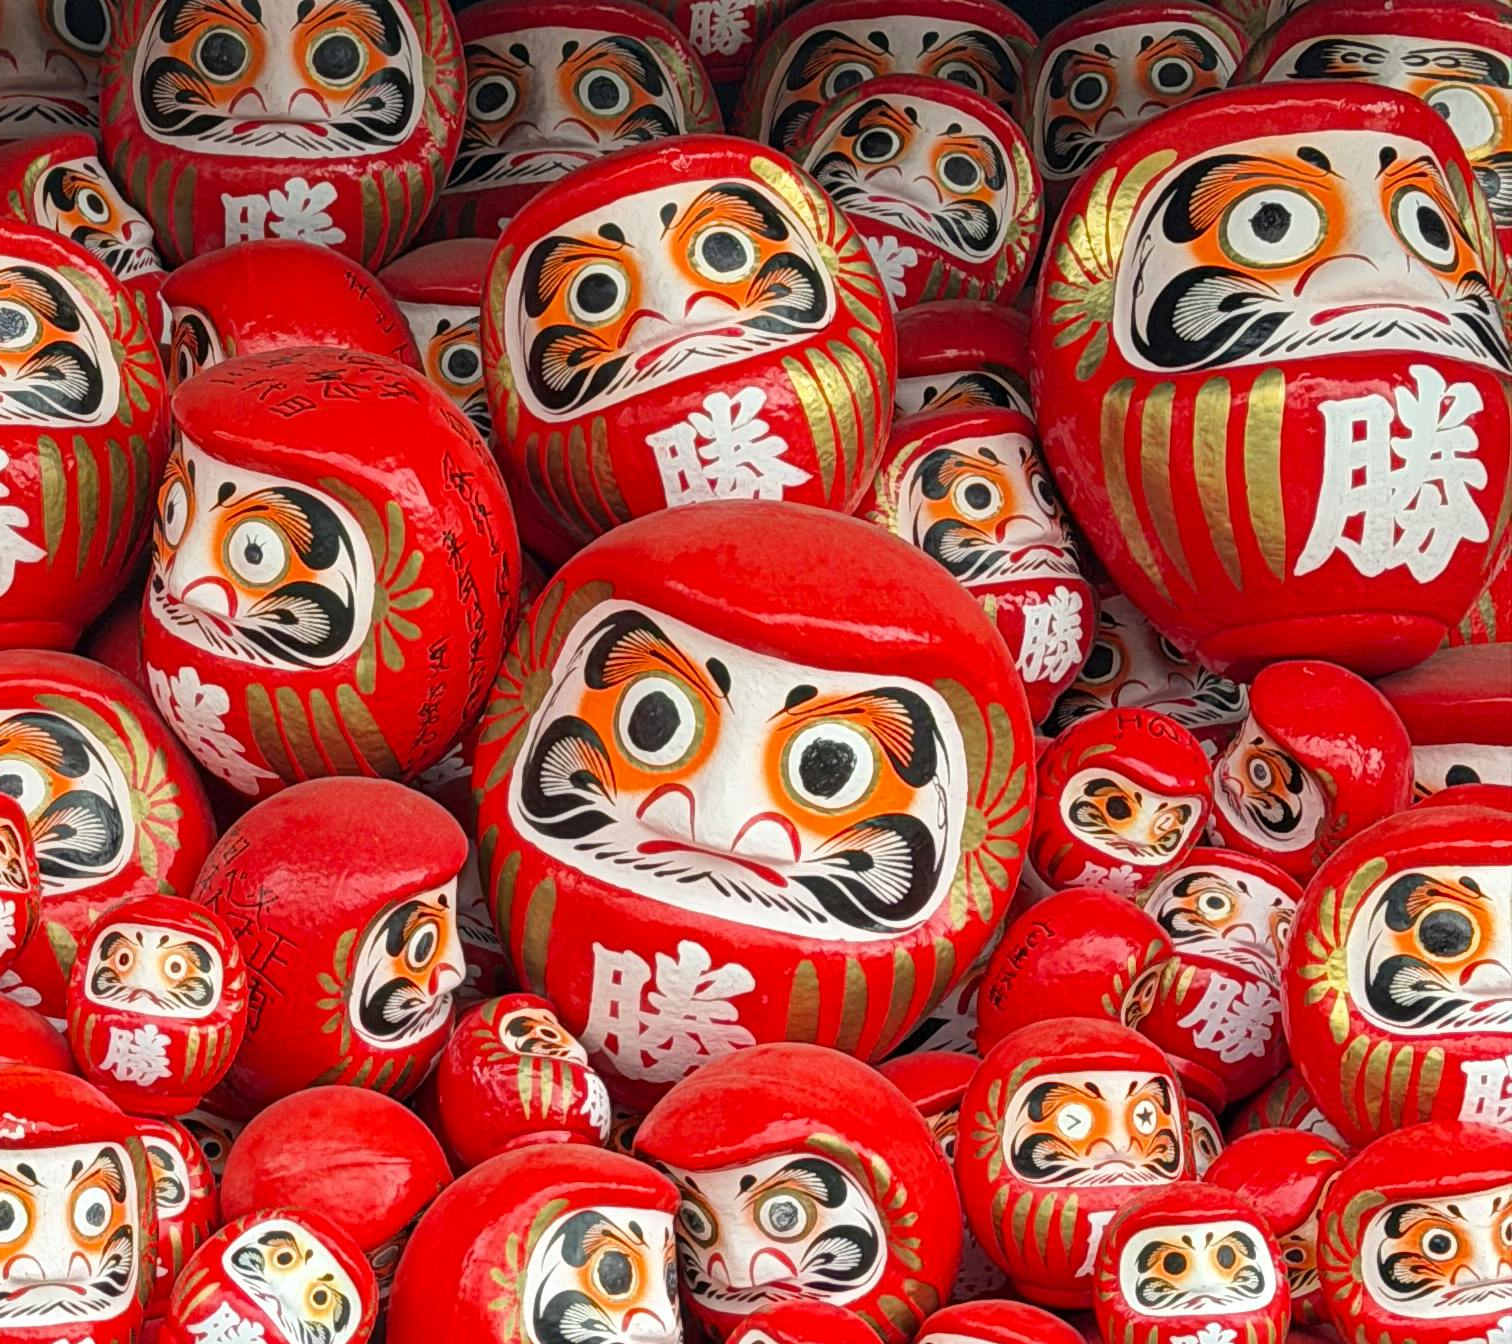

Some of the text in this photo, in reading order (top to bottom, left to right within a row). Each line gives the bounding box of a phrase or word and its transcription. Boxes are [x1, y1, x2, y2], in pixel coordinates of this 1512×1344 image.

[646, 385, 811, 508] 勝
[1294, 364, 1489, 583] 勝
[1015, 586, 1083, 683] 勝
[101, 1023, 171, 1085] 勝
[584, 939, 756, 1083] 勝
[1178, 973, 1287, 1063] 勝
